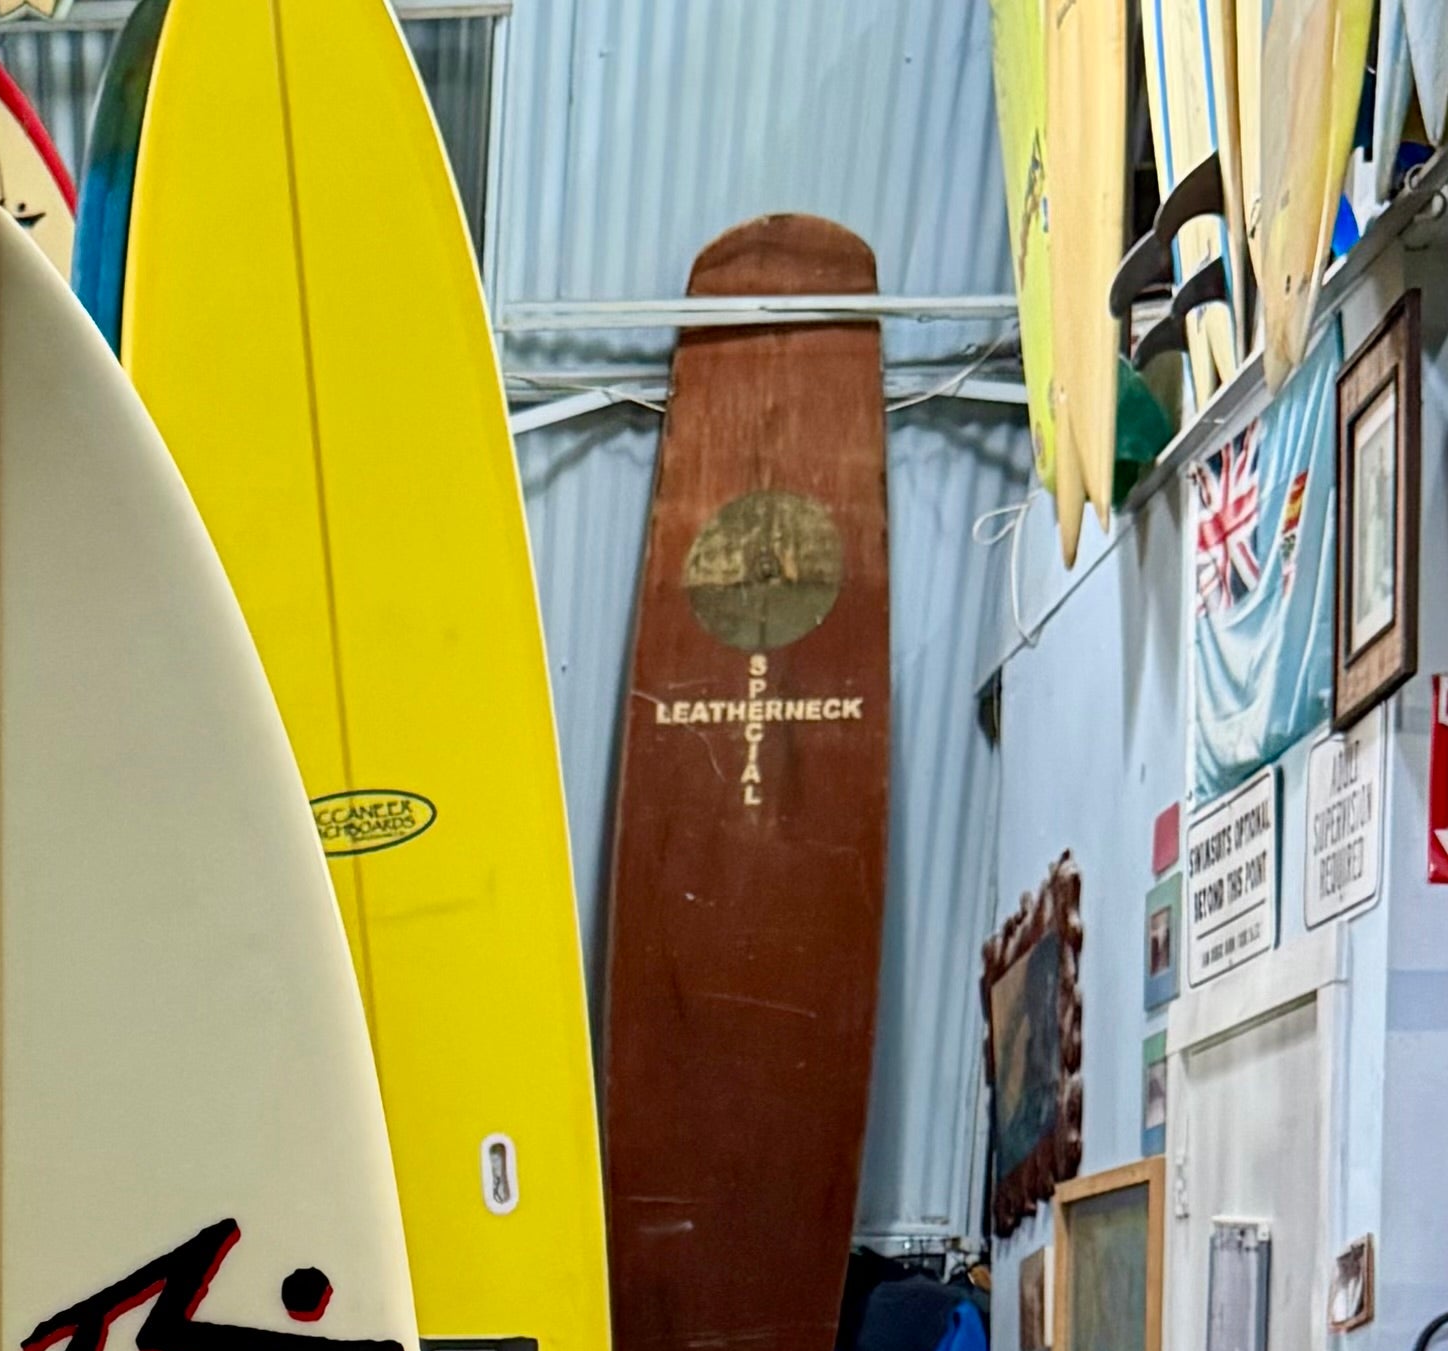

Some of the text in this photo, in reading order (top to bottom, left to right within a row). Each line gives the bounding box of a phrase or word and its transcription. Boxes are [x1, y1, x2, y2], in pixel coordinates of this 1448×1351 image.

[655, 697, 864, 725] LEATHERNECK
[740, 654, 768, 805] SPECIAL
[1234, 800, 1271, 849] OPTIONAL
[1313, 780, 1373, 855] SUPERVISION
[1194, 849, 1267, 923] BEYOND THIS POINT
[1319, 836, 1365, 900] REQUIRED
